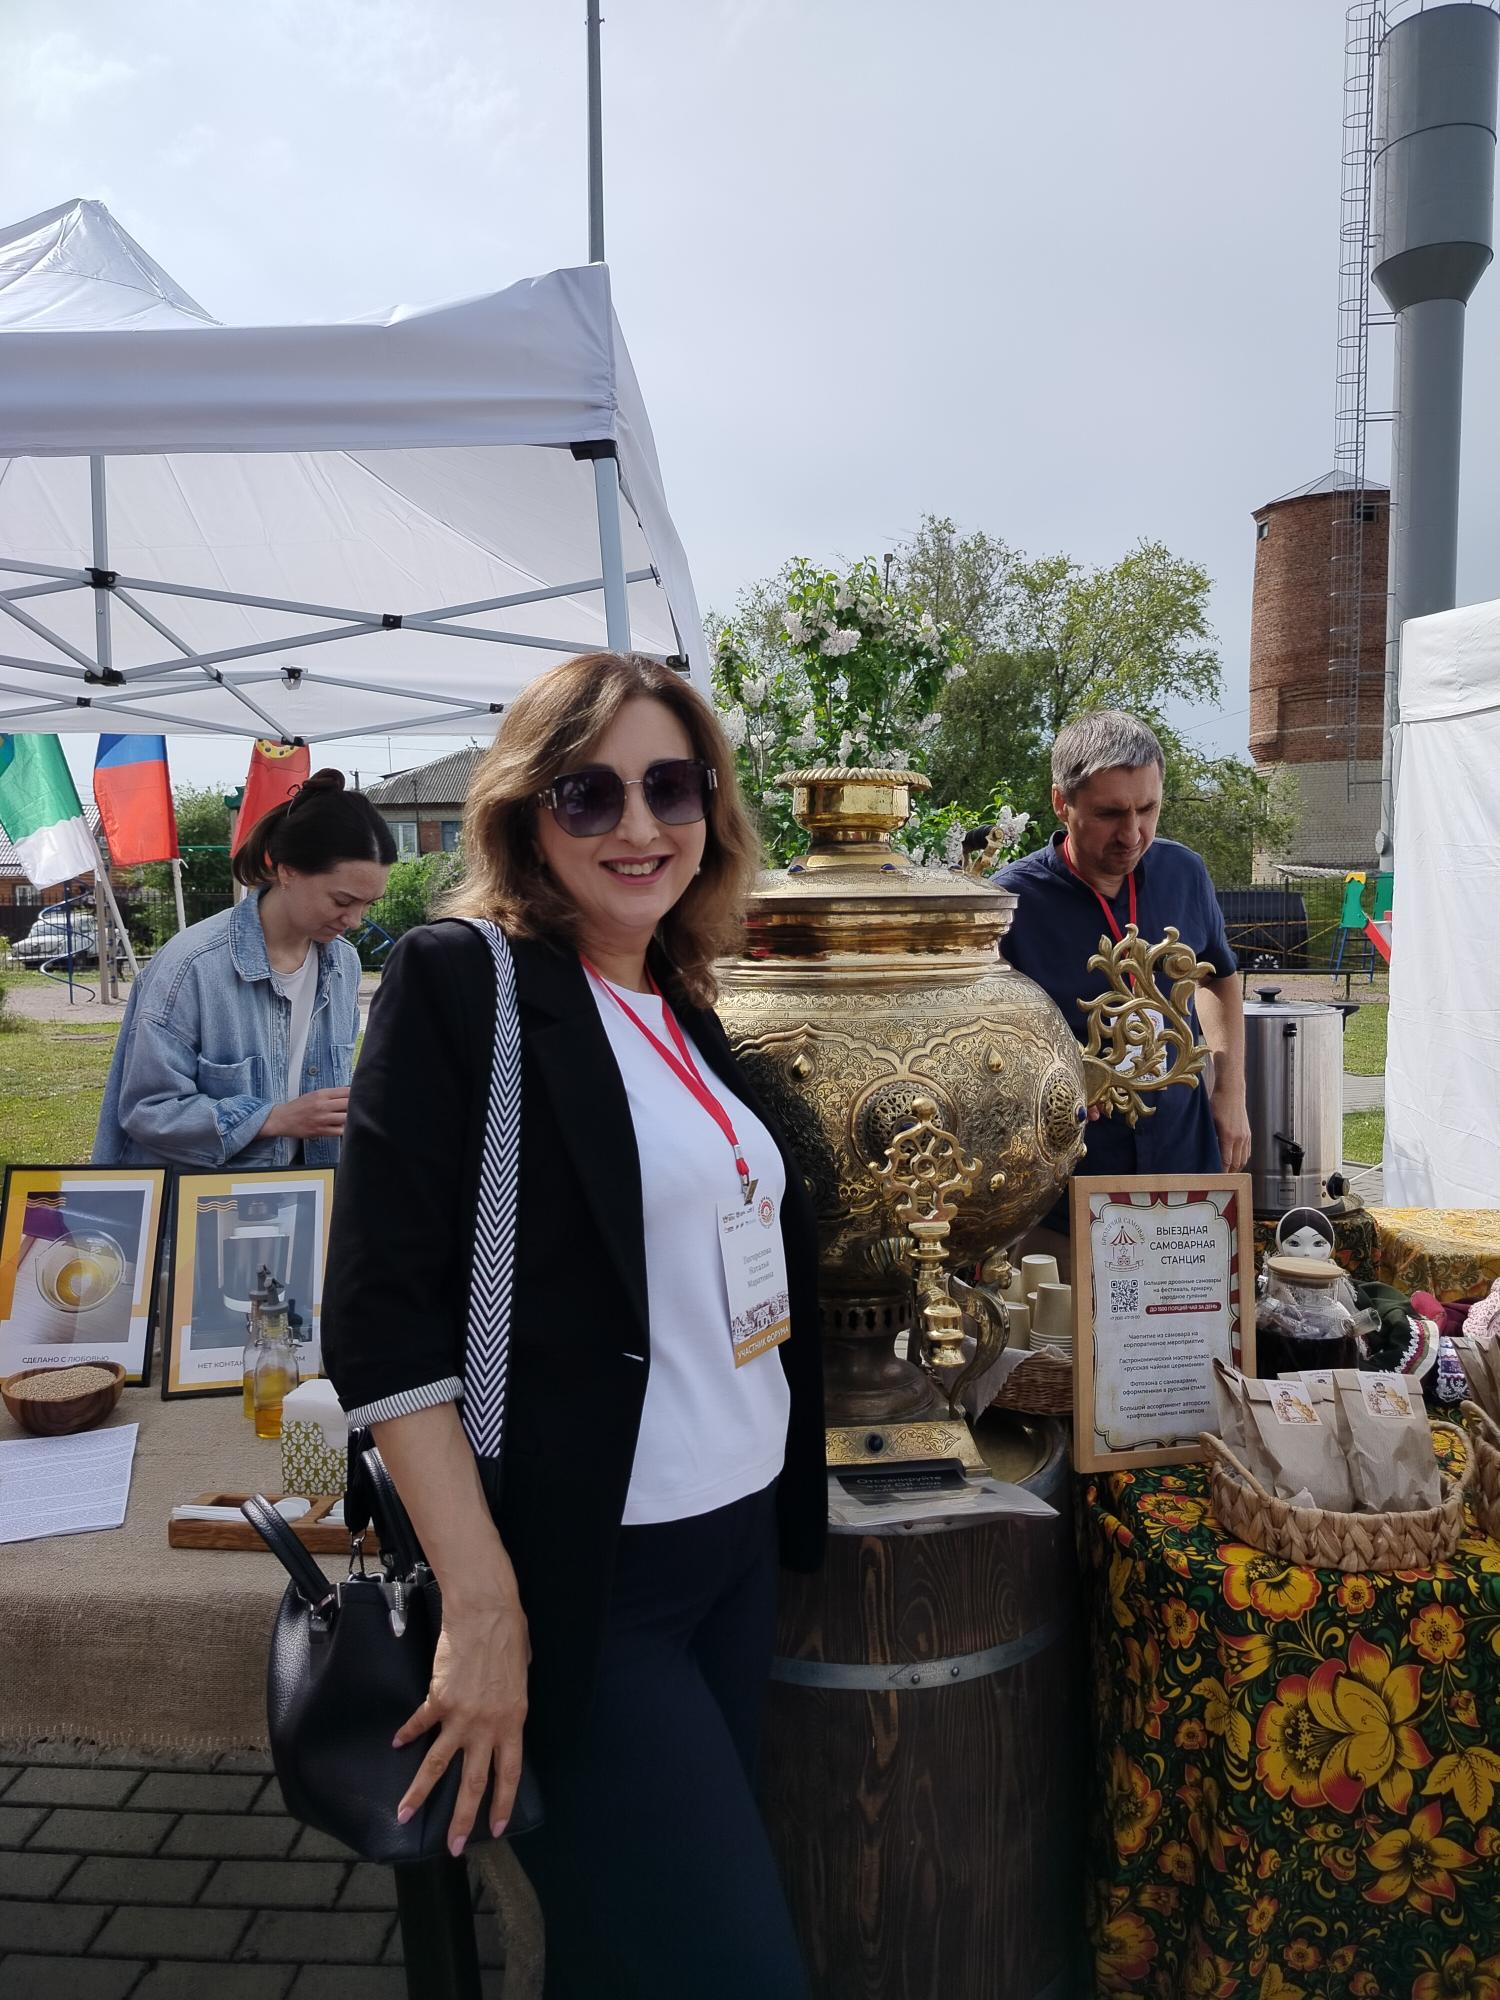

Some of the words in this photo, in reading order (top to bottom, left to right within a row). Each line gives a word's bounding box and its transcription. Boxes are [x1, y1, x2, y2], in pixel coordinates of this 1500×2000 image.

[1156, 1225, 1208, 1236] ВЫЕЗДНАЯ
[1149, 1240, 1216, 1250] САМОВАРНАЯ
[1161, 1255, 1206, 1265] СТАНЦИЯ
[1195, 1277, 1222, 1285] самовары
[1164, 1331, 1190, 1339] самовара
[737, 1338, 767, 1360] УЧАСТНИК
[766, 1325, 789, 1342] ФОРУМА
[1123, 1341, 1167, 1349] корпоративное
[1167, 1338, 1205, 1346] мероприятие
[22, 1356, 59, 1364] СДЕЛАНО
[1119, 1355, 1172, 1364] Гастрономический
[1172, 1353, 1210, 1361] мастер-класс
[1149, 1362, 1170, 1370] чайная
[1122, 1387, 1162, 1396] оформленная
[1167, 1386, 1190, 1394] русском
[1119, 1403, 1146, 1412] Большой
[1146, 1401, 1181, 1410] ассортимент
[1182, 1399, 1210, 1408] авторских
[1126, 1411, 1157, 1420] крафтовых
